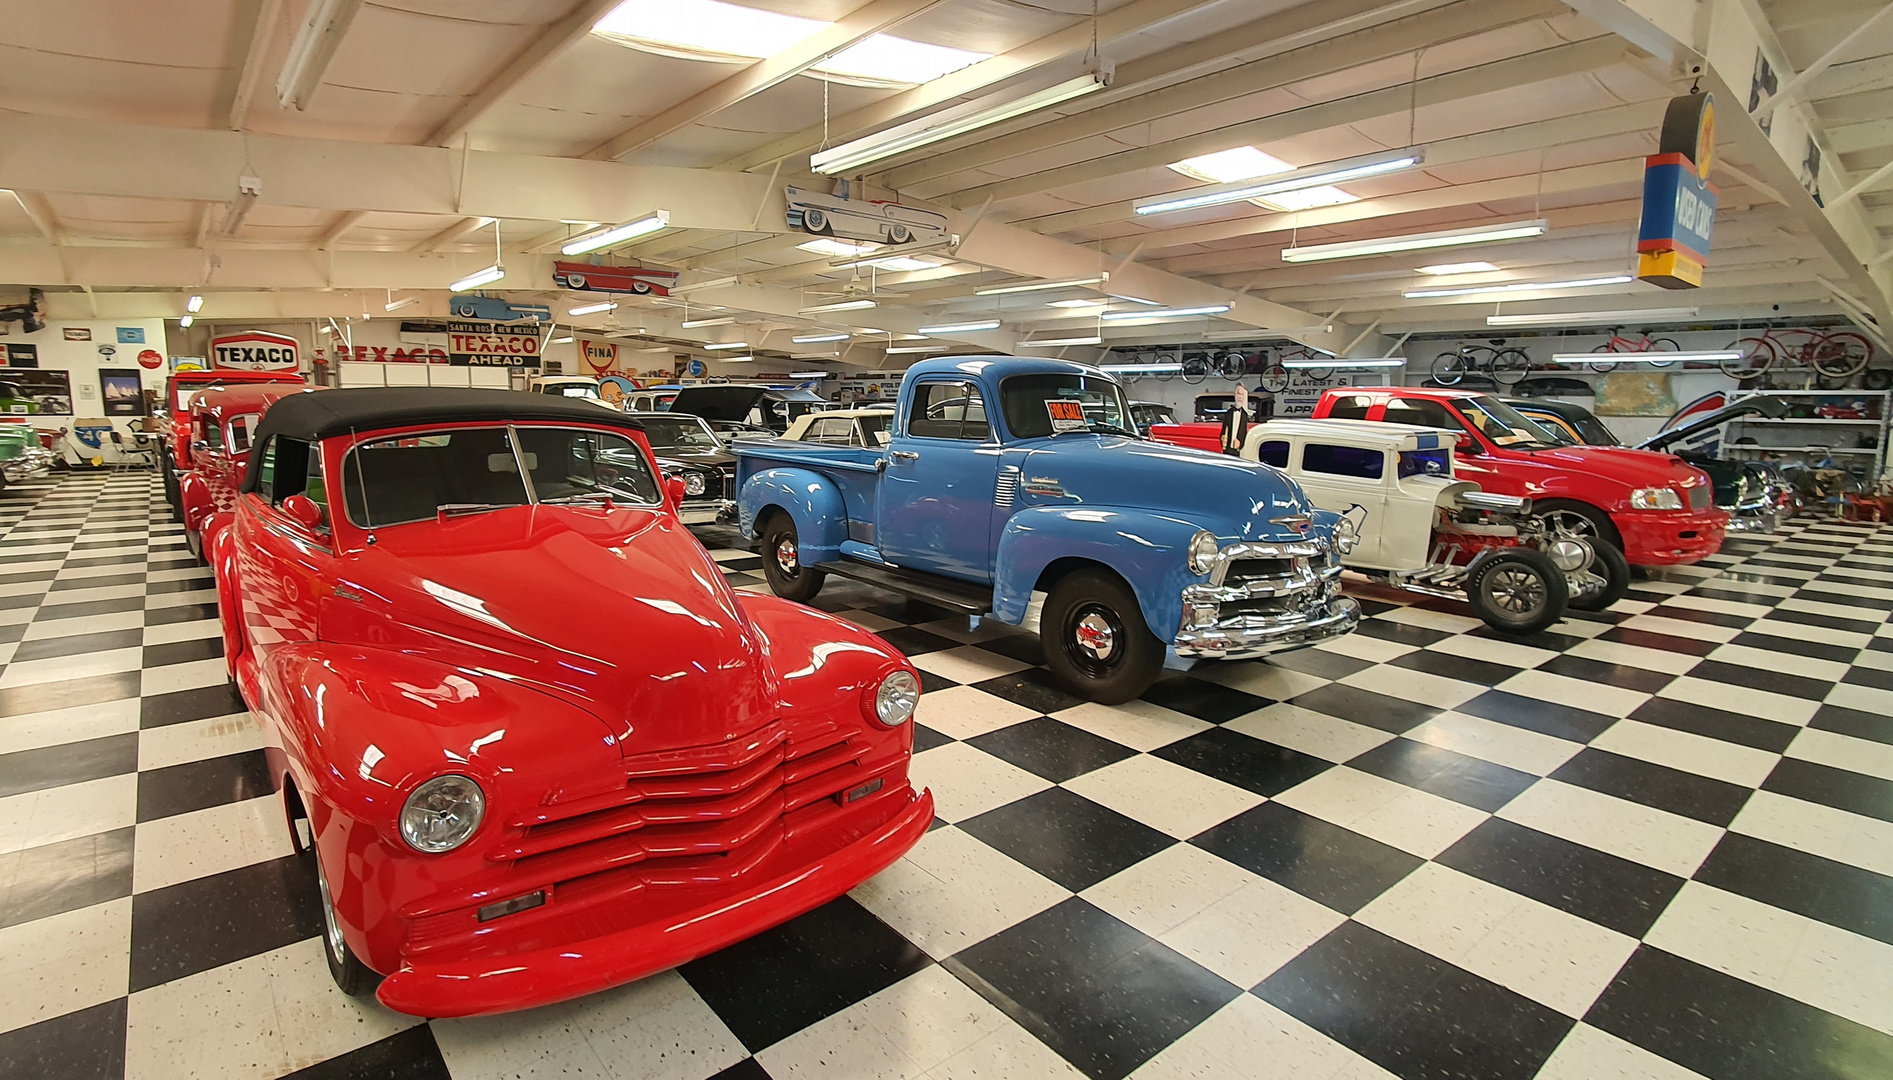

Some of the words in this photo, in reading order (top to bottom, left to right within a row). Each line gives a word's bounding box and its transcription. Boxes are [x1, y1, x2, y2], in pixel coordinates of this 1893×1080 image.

[449, 323, 474, 332] SANTA
[514, 326, 538, 334] MEXICO
[451, 334, 537, 354] TEXACO
[216, 347, 294, 363] TEXACO
[337, 345, 447, 363] TEXACO
[587, 347, 612, 358] FINA
[468, 355, 524, 366] AHEAD
[1292, 379, 1334, 387] LATEST
[1337, 378, 1347, 386] &
[1281, 388, 1319, 396] FINEST
[1048, 403, 1066, 419] FOR
[1063, 403, 1083, 419] SALE
